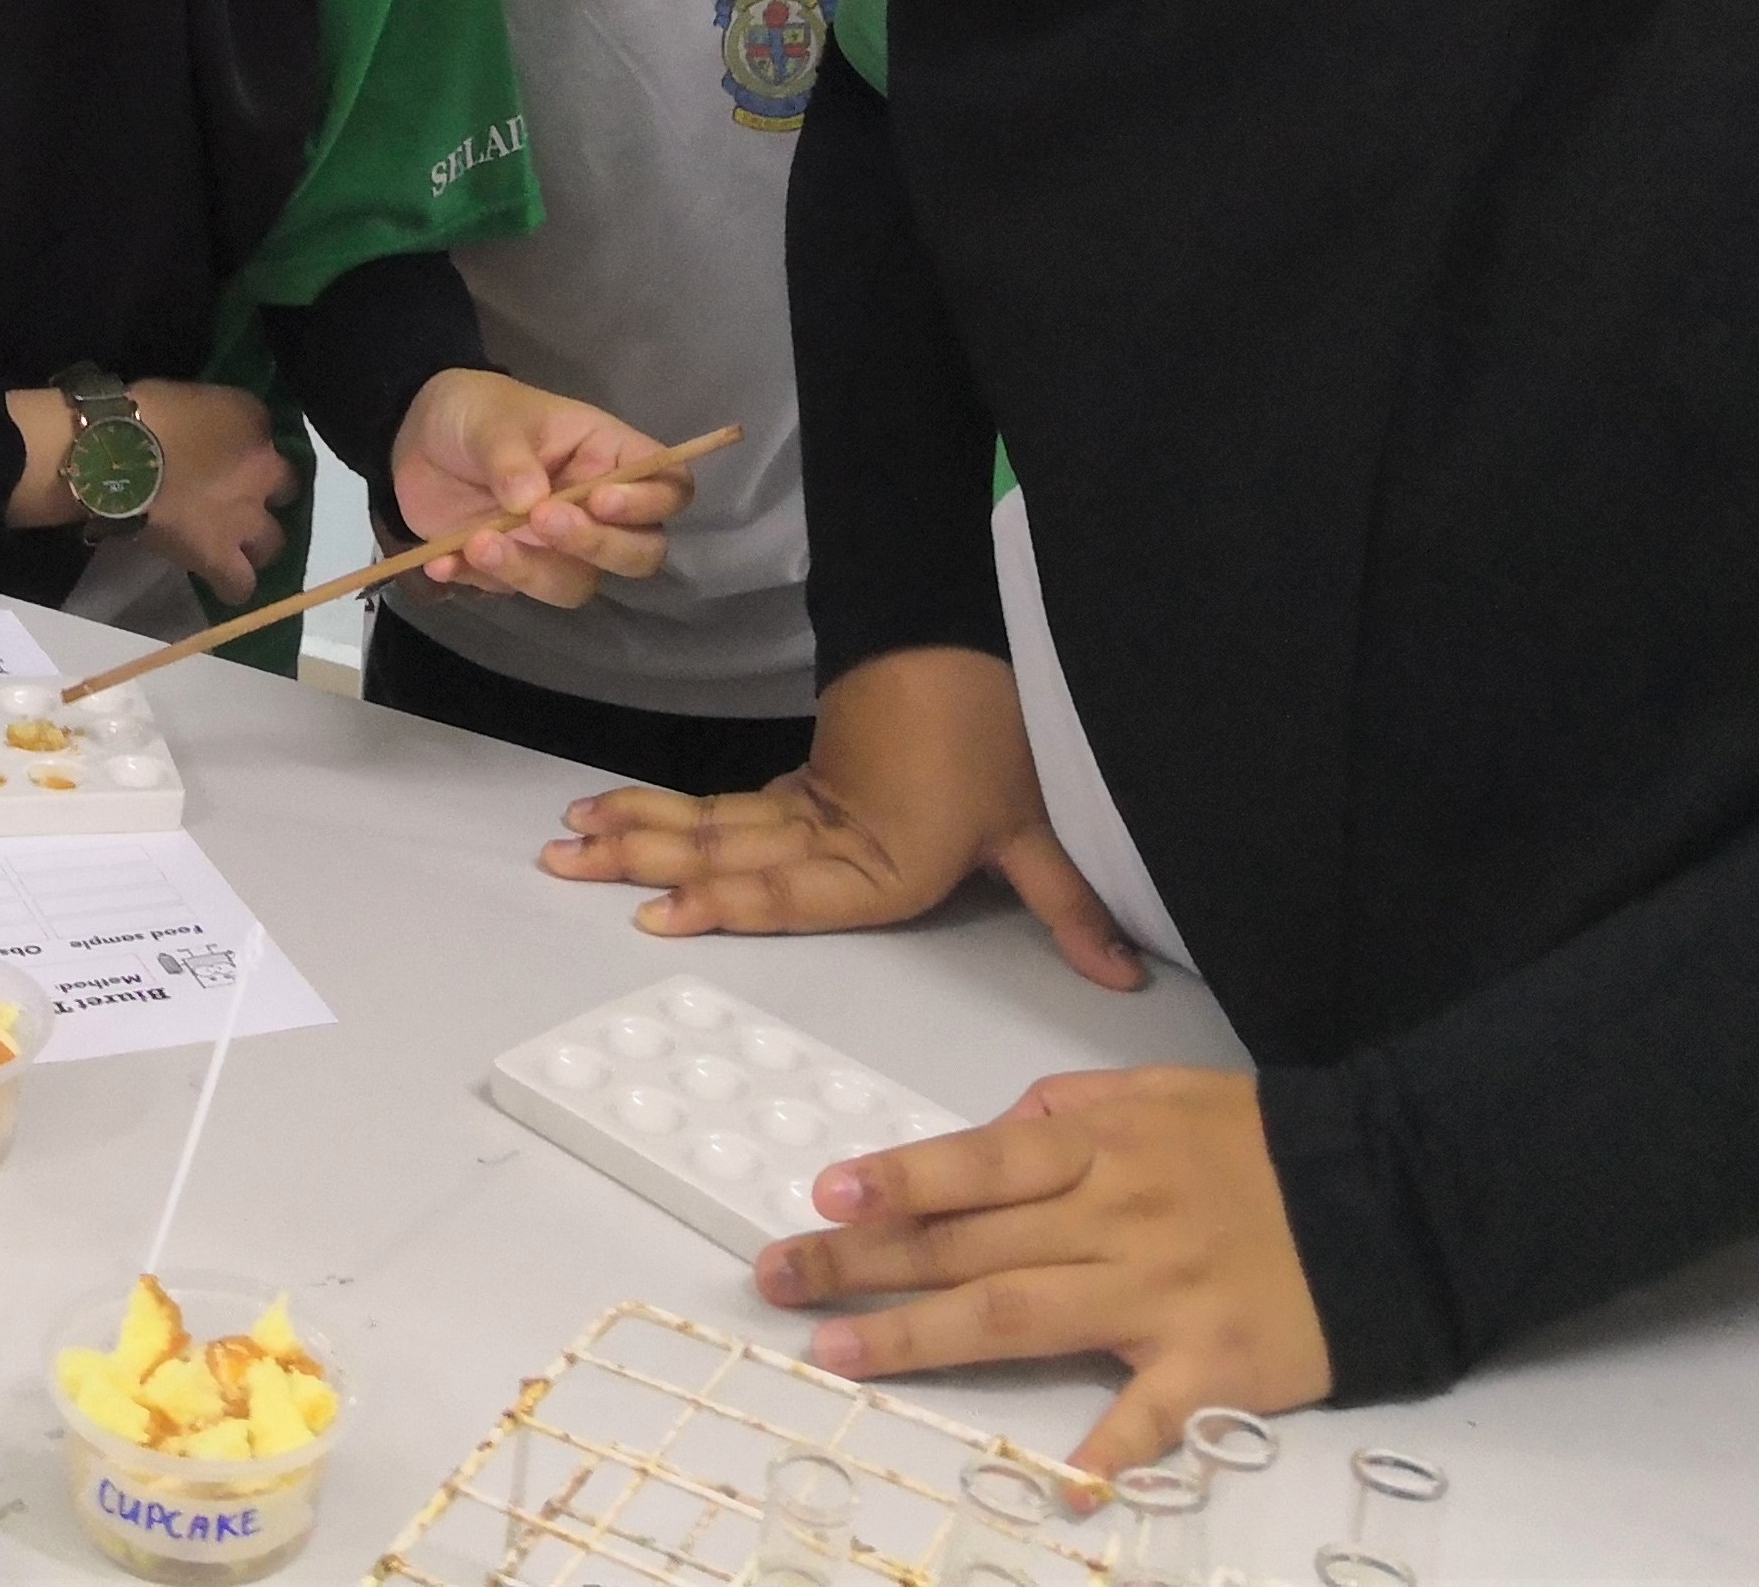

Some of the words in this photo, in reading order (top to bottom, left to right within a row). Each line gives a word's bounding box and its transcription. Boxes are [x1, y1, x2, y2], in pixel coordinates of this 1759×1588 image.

[70, 931, 146, 950] sample
[150, 923, 204, 942] Food
[78, 986, 173, 1010] Biuret
[99, 1477, 263, 1543] CUPCAKE
